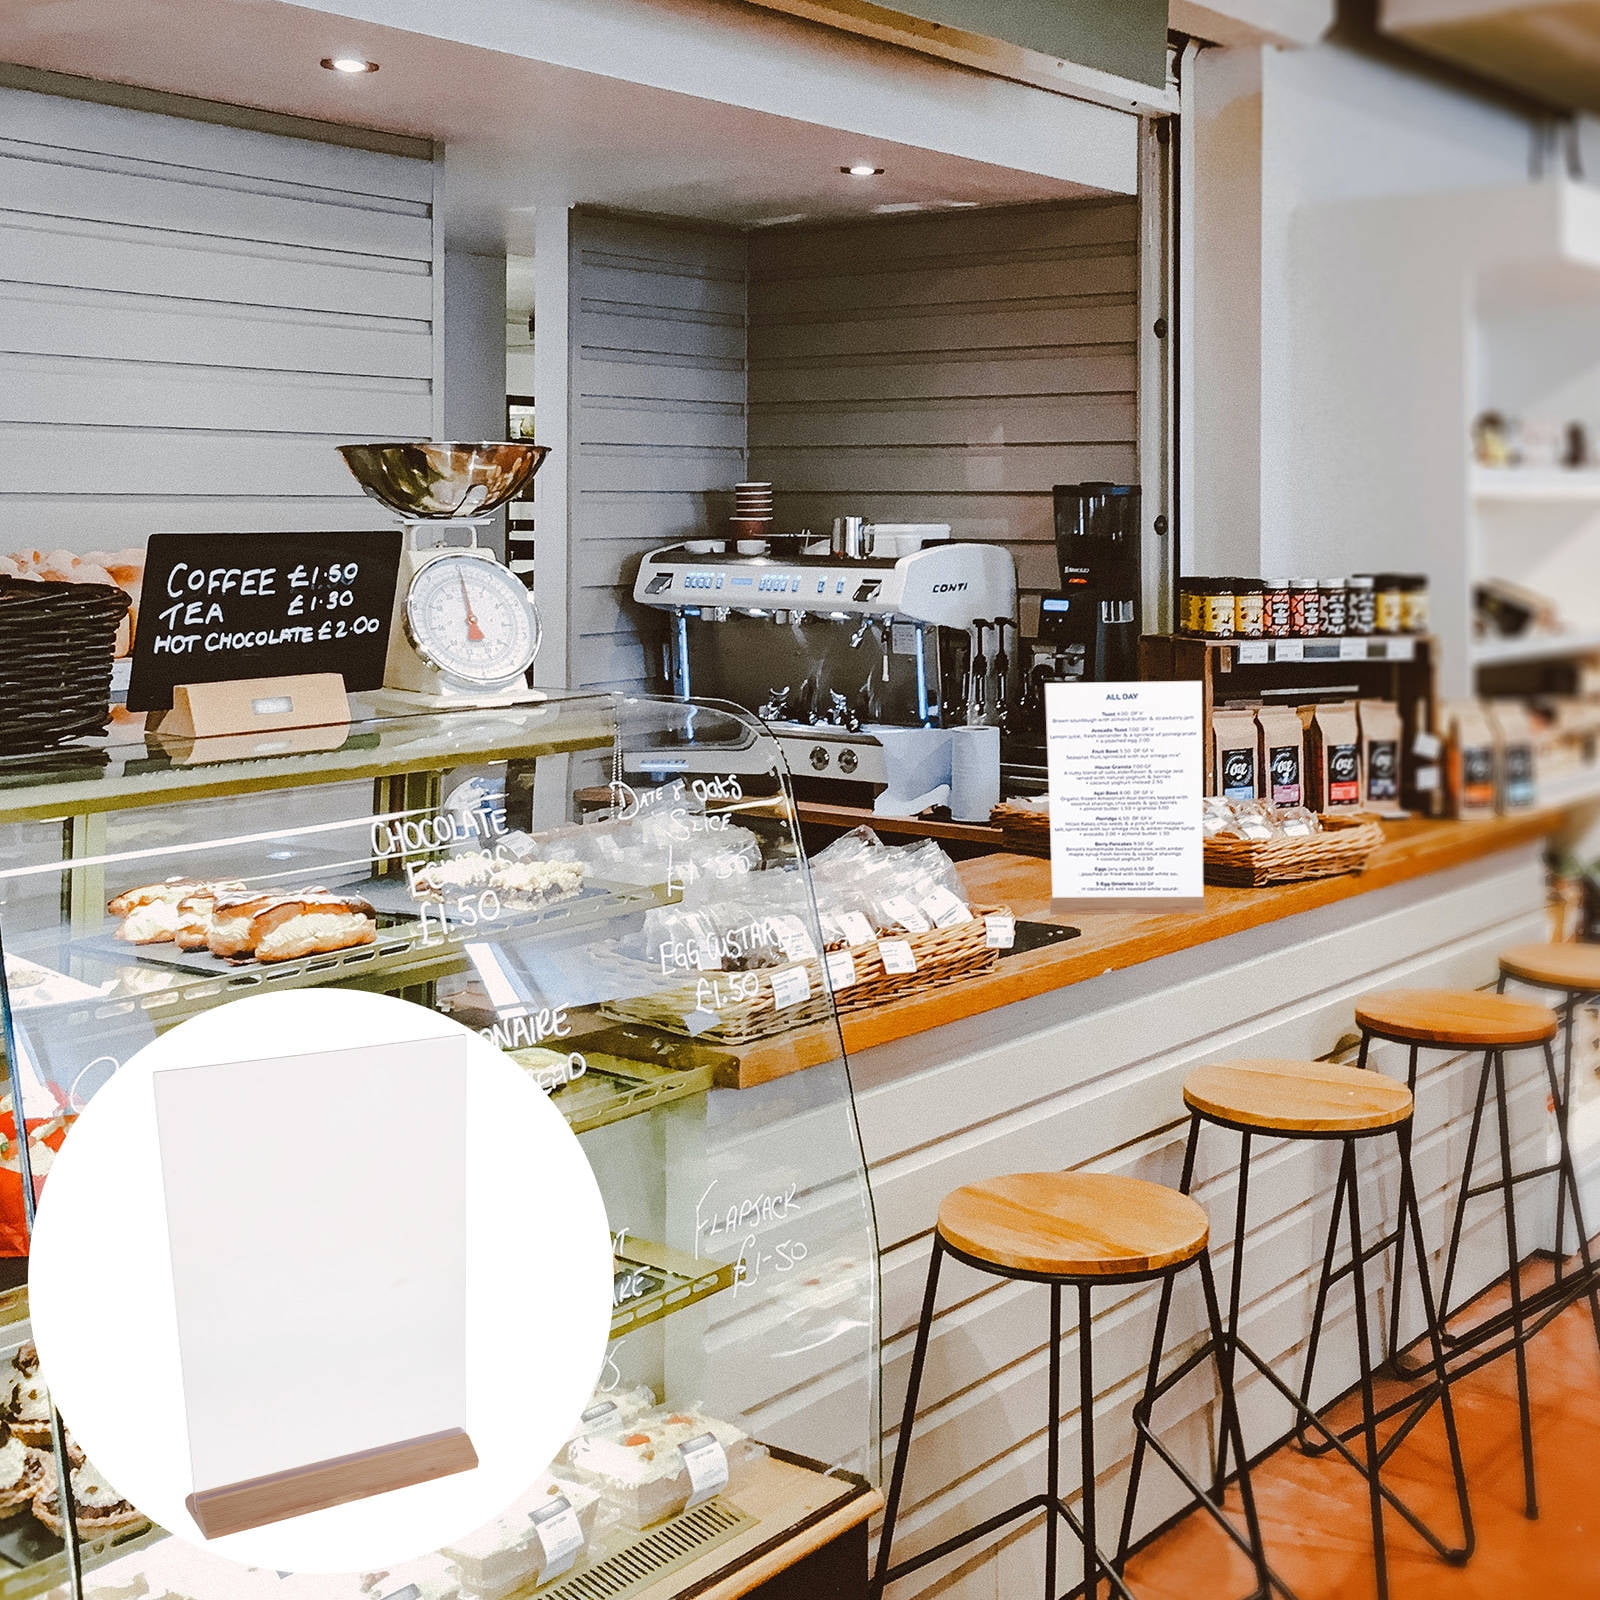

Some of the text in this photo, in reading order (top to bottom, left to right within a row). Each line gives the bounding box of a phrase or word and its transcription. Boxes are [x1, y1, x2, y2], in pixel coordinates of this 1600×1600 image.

[167, 563, 276, 598] COFFEE
[932, 582, 968, 593] CONTI
[153, 616, 380, 654] HOT CHOCOLATE £2.00
[159, 601, 224, 631] TEA
[371, 808, 509, 856] CHOCOLATE
[417, 890, 500, 945] £1.50
[659, 939, 703, 976] EGG
[705, 919, 788, 962] CUSTAR
[696, 972, 759, 1014] £1.50
[695, 1179, 801, 1260] FLAPJACK
